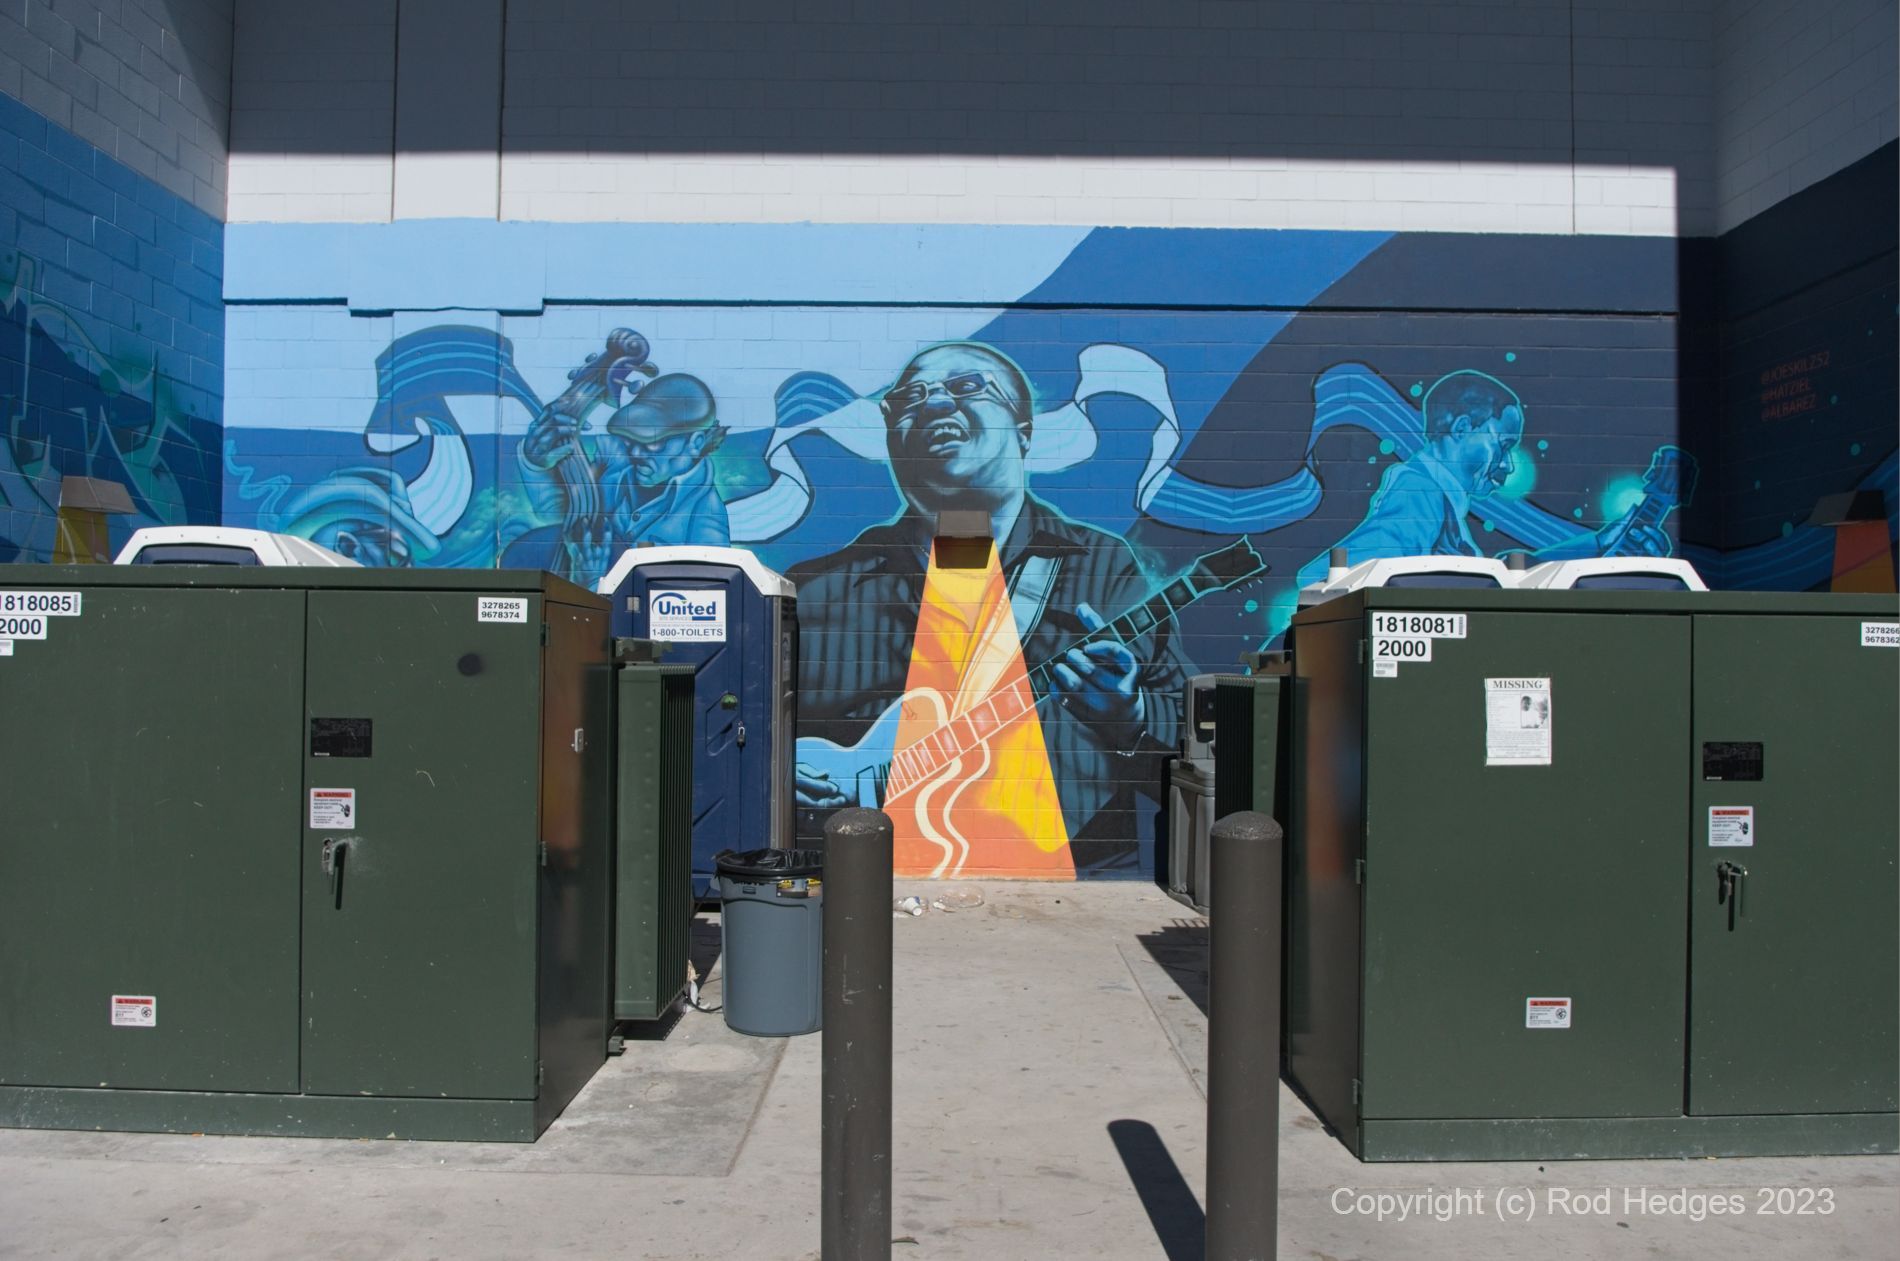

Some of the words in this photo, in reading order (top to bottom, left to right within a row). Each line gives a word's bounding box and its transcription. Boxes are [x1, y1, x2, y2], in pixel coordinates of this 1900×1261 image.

[481, 602, 520, 610] 3278265
[658, 601, 716, 615] United
[481, 611, 520, 619] 9678374
[0, 619, 41, 634] 2000
[1376, 616, 1454, 633] 1818081
[652, 628, 723, 637] 1-800-TOILETS
[1378, 640, 1426, 657] 2000
[1493, 680, 1543, 689] MISSING
